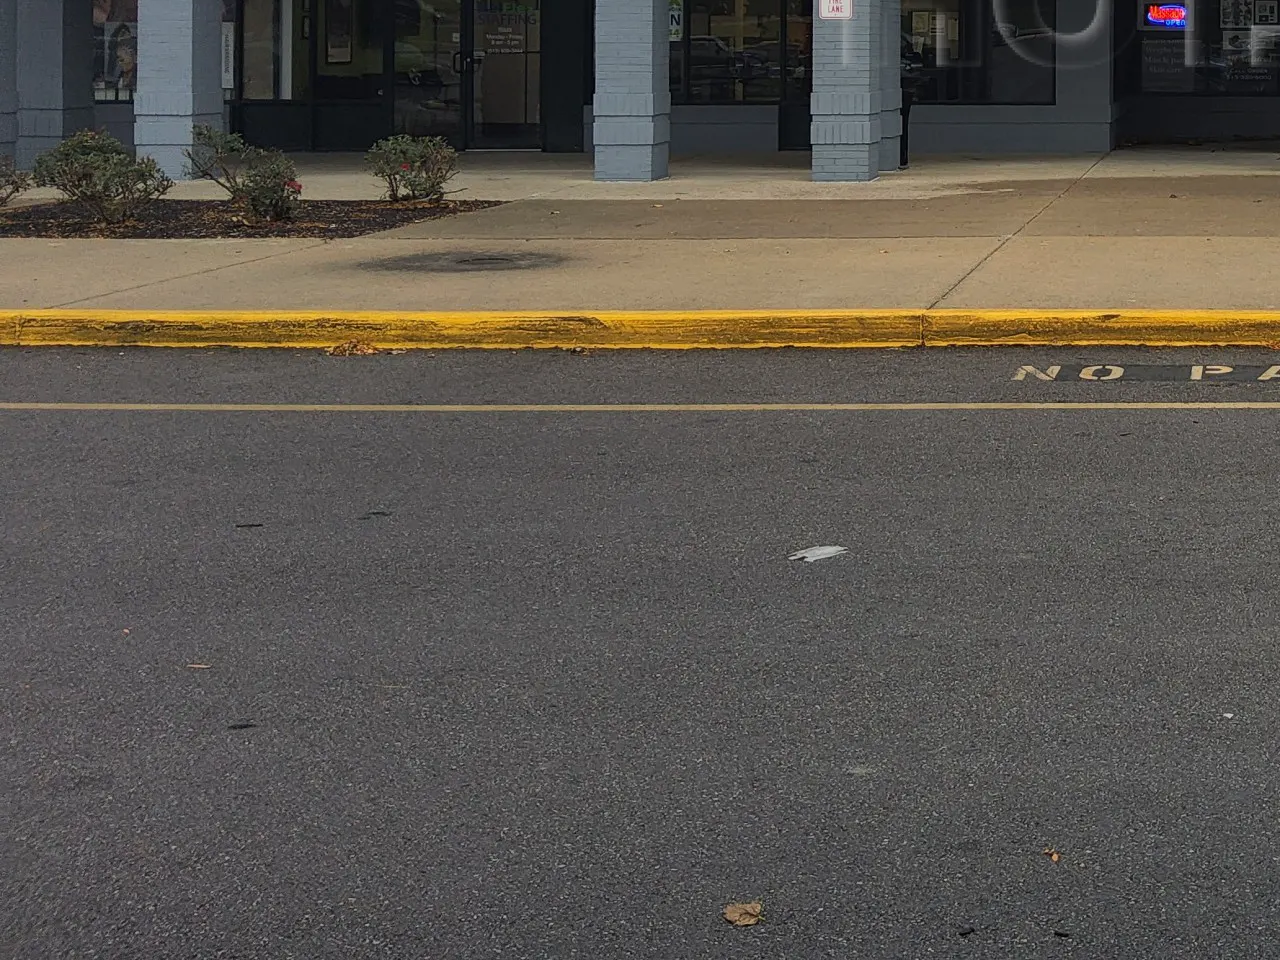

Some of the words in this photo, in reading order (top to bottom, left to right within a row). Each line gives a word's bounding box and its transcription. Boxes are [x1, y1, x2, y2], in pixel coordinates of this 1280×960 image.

[828, 5, 844, 13] LANE
[1149, 4, 1185, 20] Massage
[1010, 365, 1126, 381] NO
